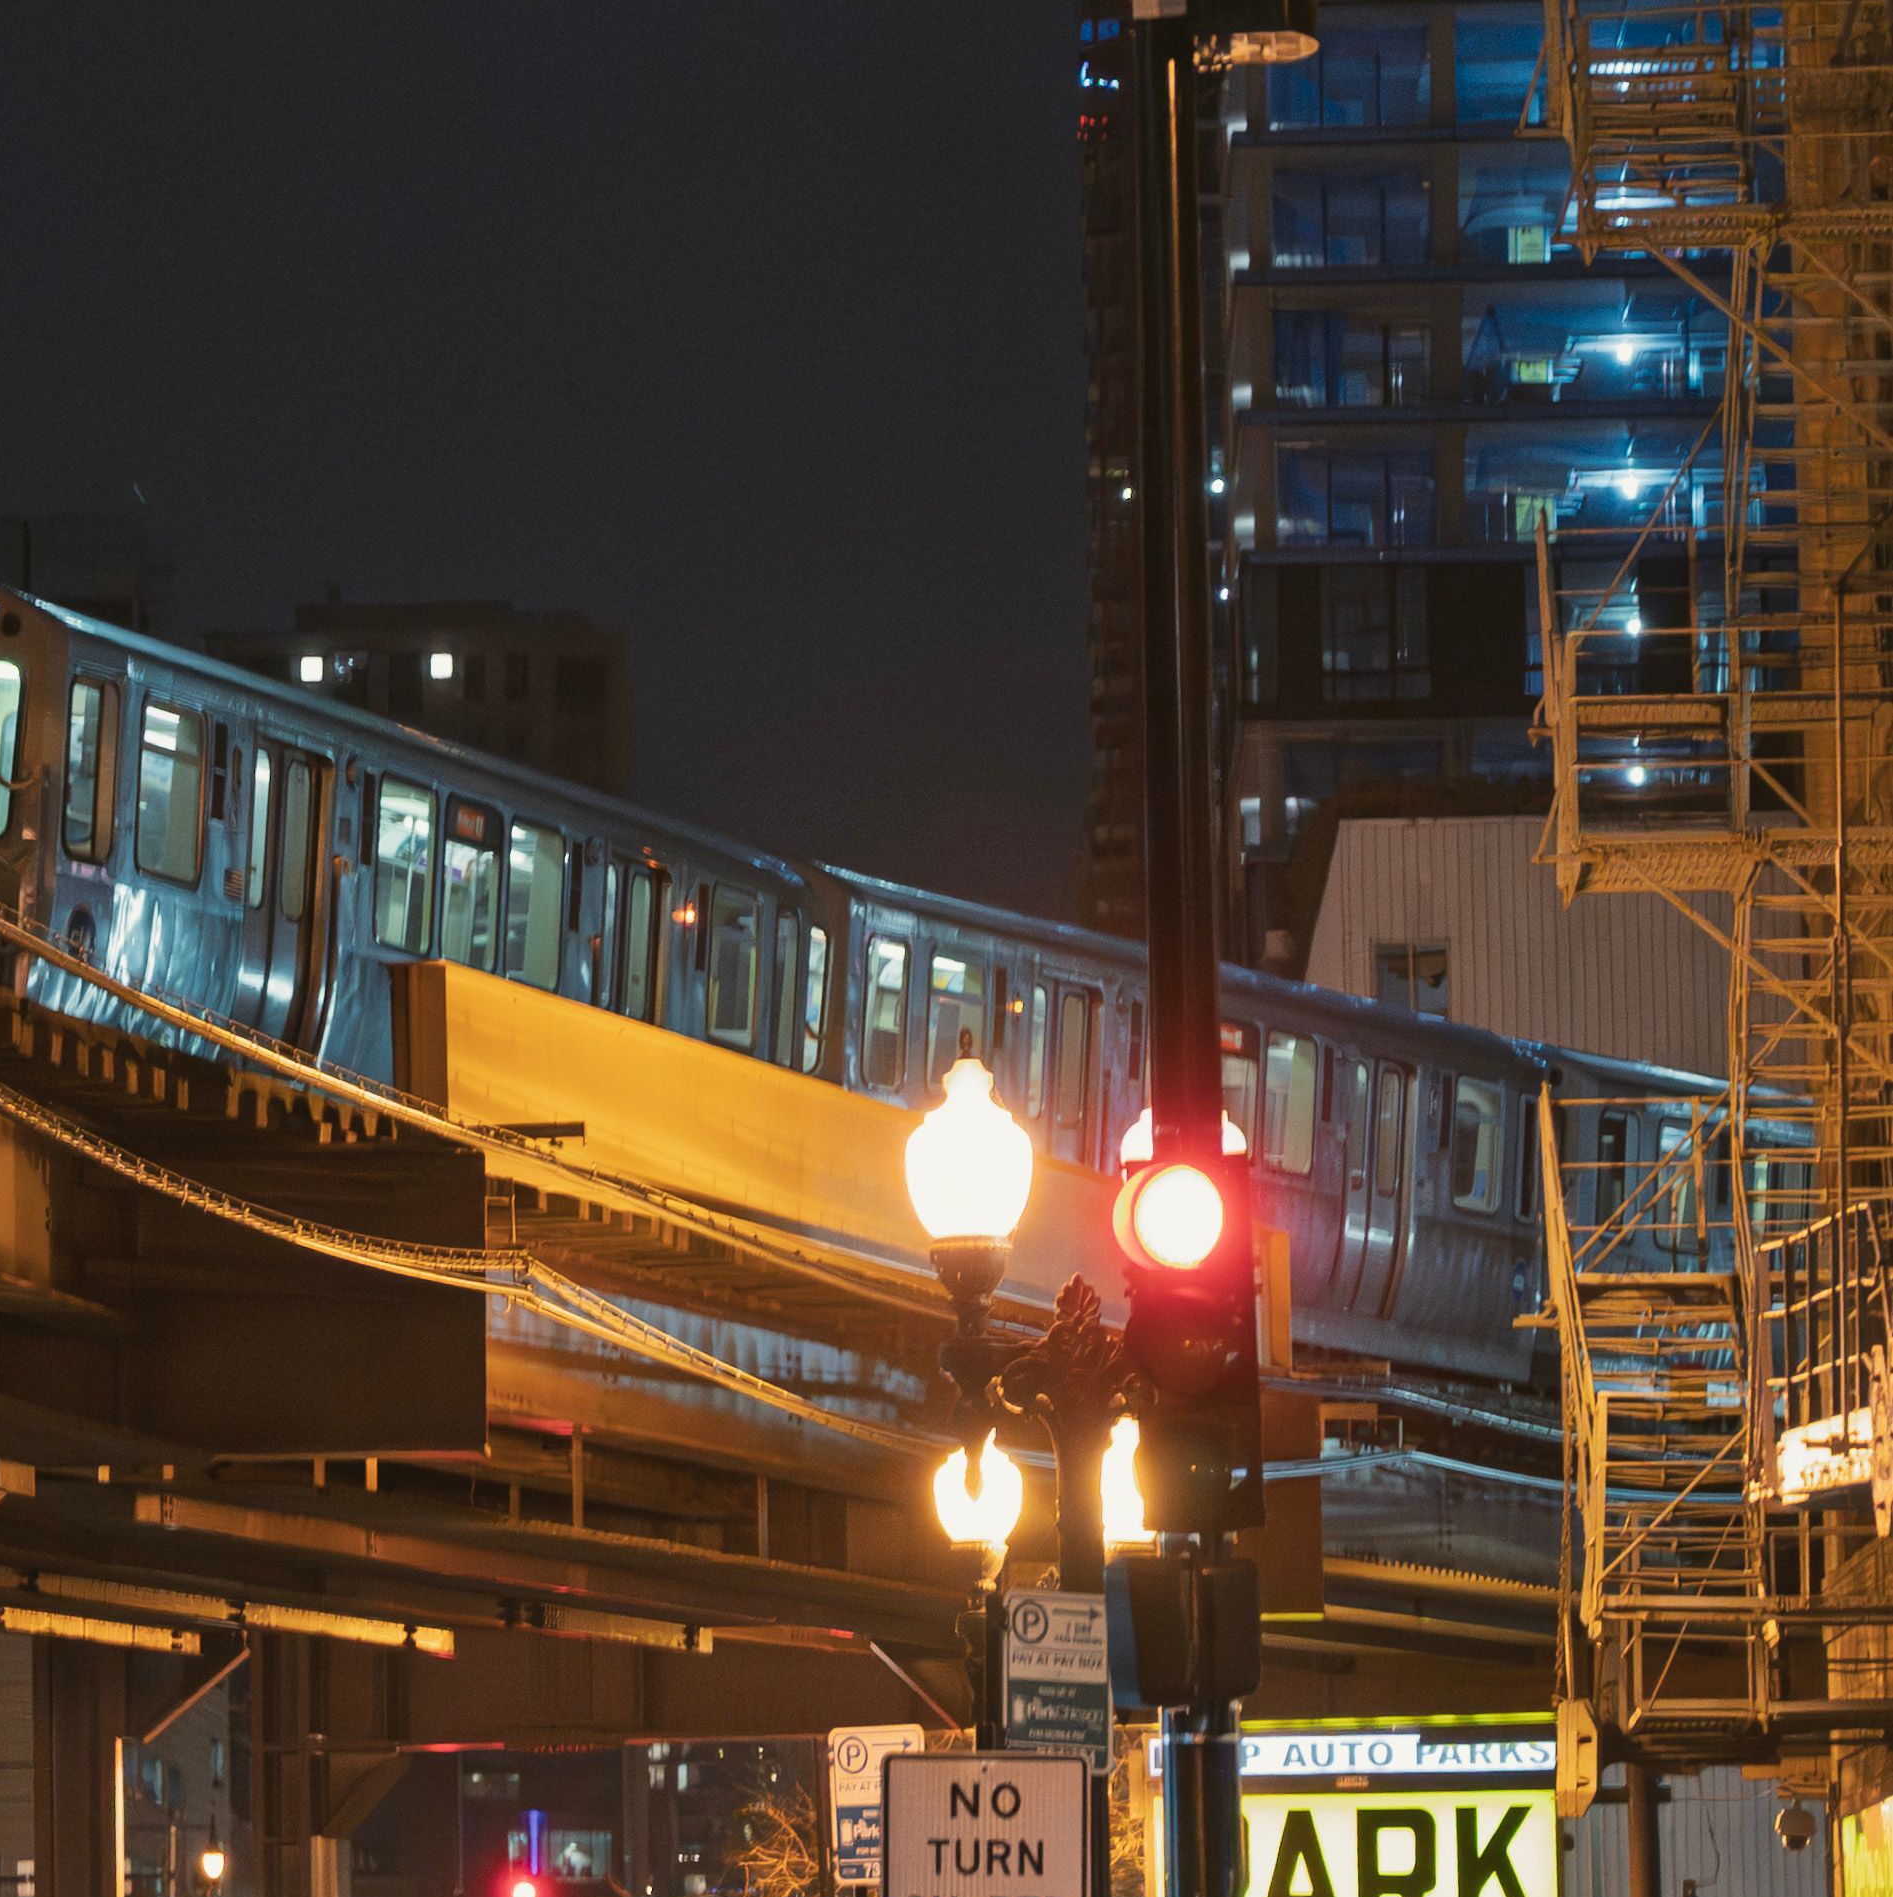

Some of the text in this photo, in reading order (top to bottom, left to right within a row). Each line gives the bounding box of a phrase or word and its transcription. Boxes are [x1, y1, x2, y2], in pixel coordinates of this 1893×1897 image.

[1282, 1741, 1394, 1768] AUTO
[1415, 1741, 1552, 1766] PARKS
[950, 1780, 1021, 1820] NO
[927, 1838, 1045, 1877] TURN
